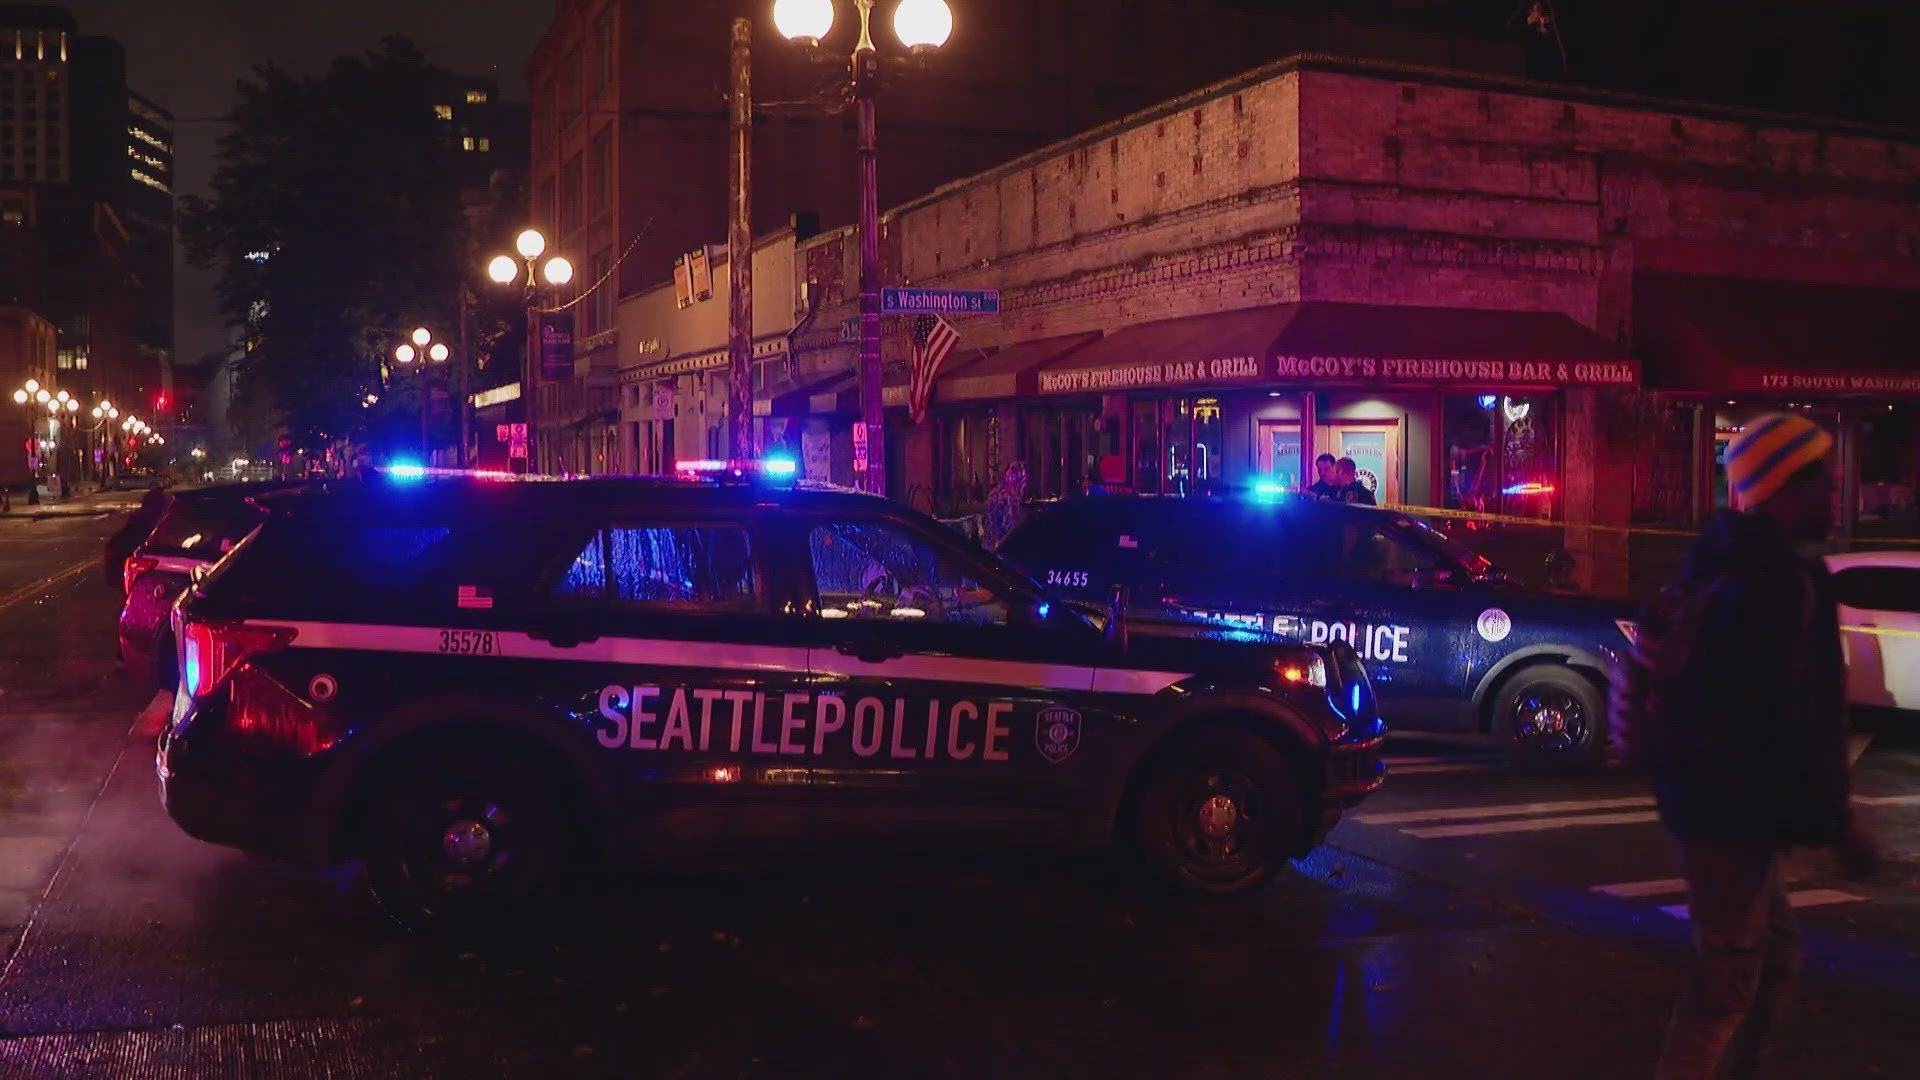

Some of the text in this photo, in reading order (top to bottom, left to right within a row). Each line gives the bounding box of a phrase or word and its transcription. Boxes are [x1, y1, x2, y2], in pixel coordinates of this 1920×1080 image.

[898, 291, 968, 313] Washington
[971, 296, 982, 310] St
[1090, 364, 1161, 389] FIREHOUSE
[1165, 360, 1194, 382] BAR
[1197, 359, 1206, 380] &
[1210, 356, 1258, 379] GRILL
[1277, 355, 1633, 383] McCOY'S FIREHOUSE BAR & GRILL
[1762, 374, 1789, 389] 173
[1047, 569, 1089, 588] 34655
[439, 631, 493, 654] 35578
[1311, 620, 1410, 662] POLICE
